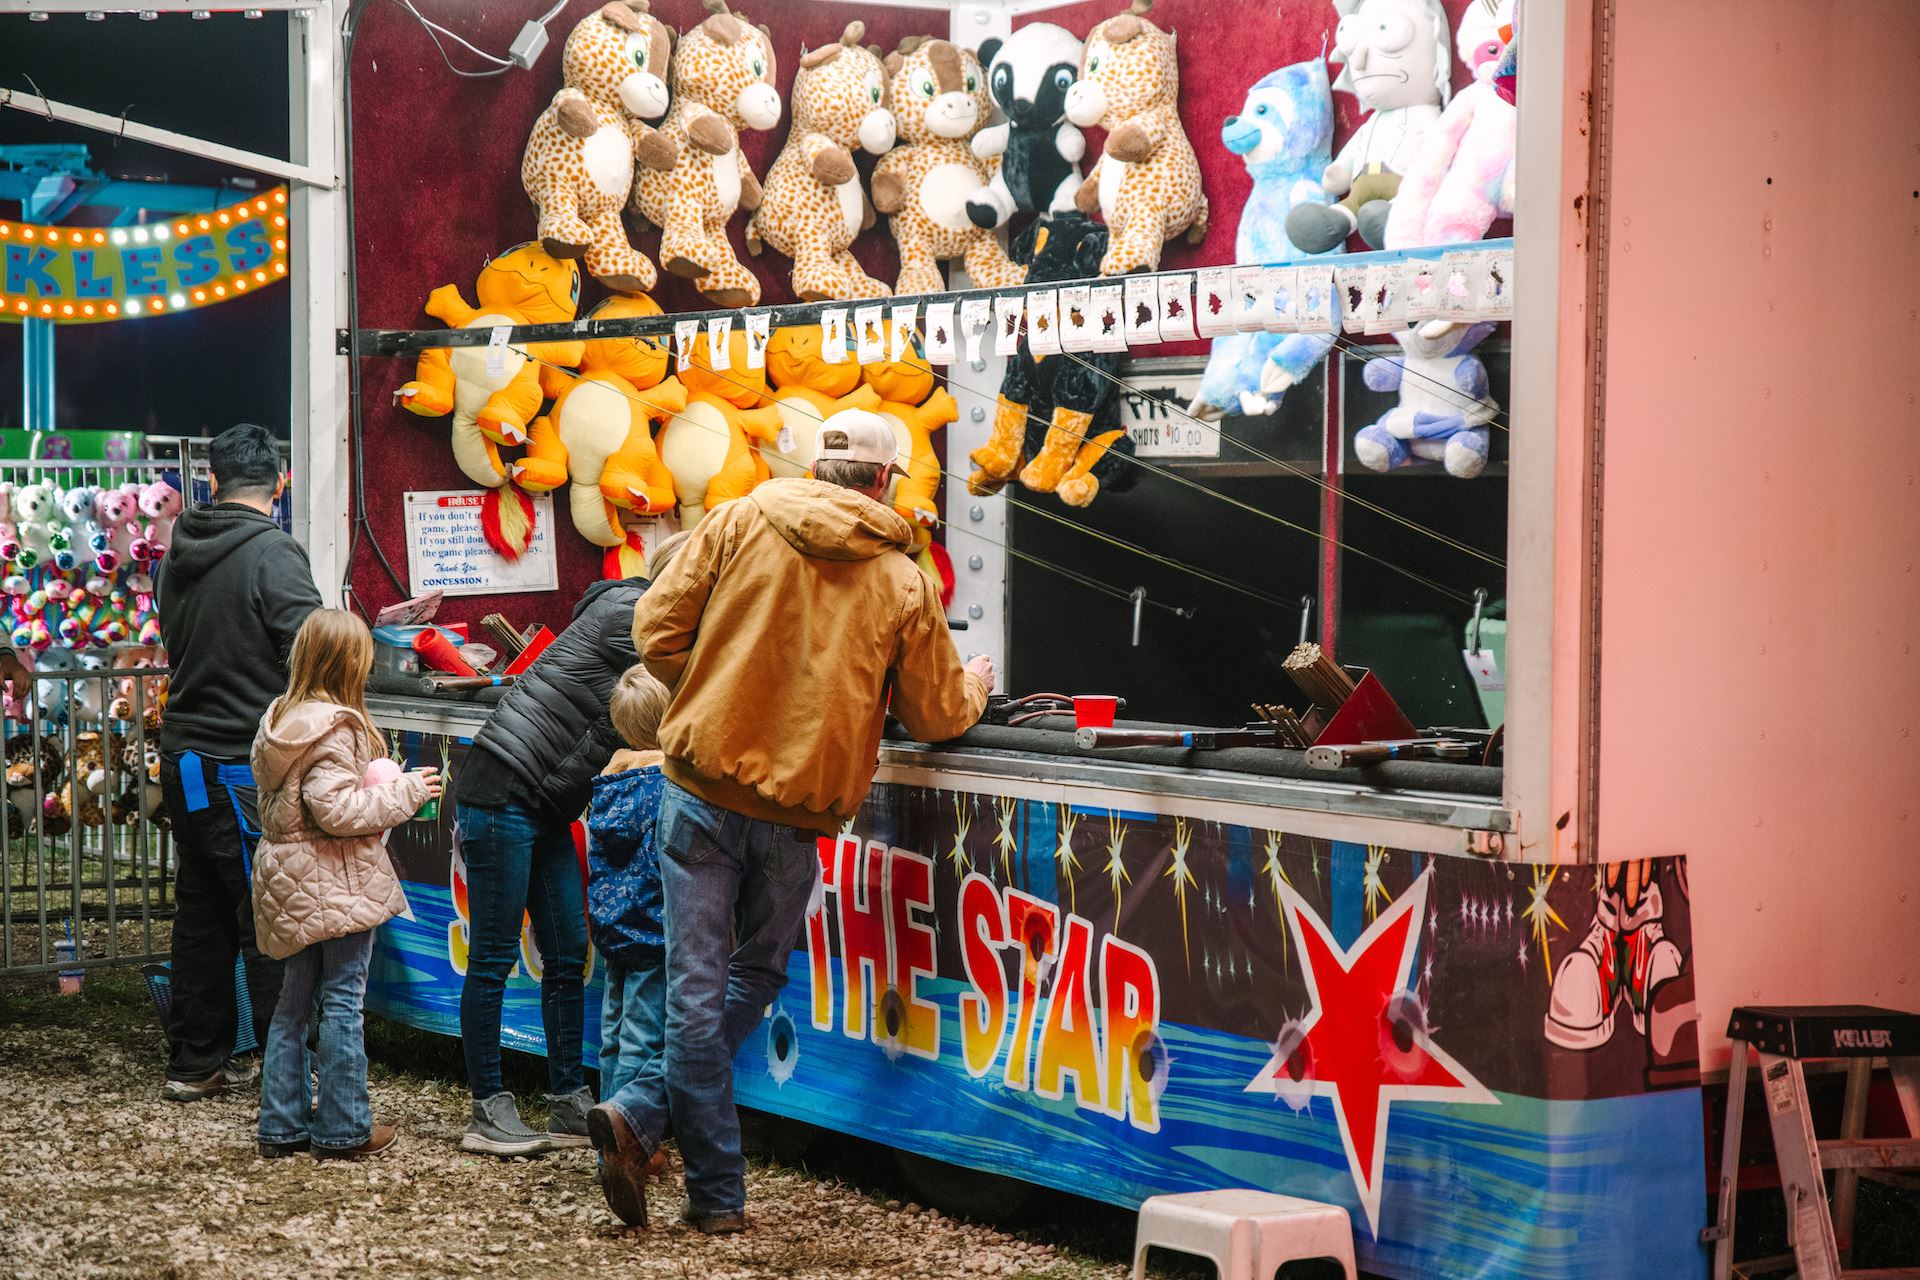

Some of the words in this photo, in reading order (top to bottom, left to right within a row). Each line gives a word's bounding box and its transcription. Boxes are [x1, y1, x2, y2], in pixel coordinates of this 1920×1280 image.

[5, 219, 272, 298] KLESS
[1133, 428, 1160, 446] SHOTS
[447, 497, 480, 506] HOUSE
[419, 512, 427, 521] If
[429, 513, 445, 523] you
[447, 511, 472, 520] don't
[421, 526, 449, 535] game,
[451, 523, 478, 534] please
[429, 538, 446, 547] you
[448, 535, 464, 544] still
[466, 535, 484, 544] don
[422, 549, 437, 557] the
[438, 549, 463, 559] game
[464, 547, 492, 558] please
[433, 562, 459, 573] Thank
[461, 562, 478, 573] You
[422, 576, 482, 587] CONCESSION
[804, 832, 941, 1062] THE
[957, 871, 1163, 1134] STAR
[1832, 1029, 1893, 1049] KELLER
